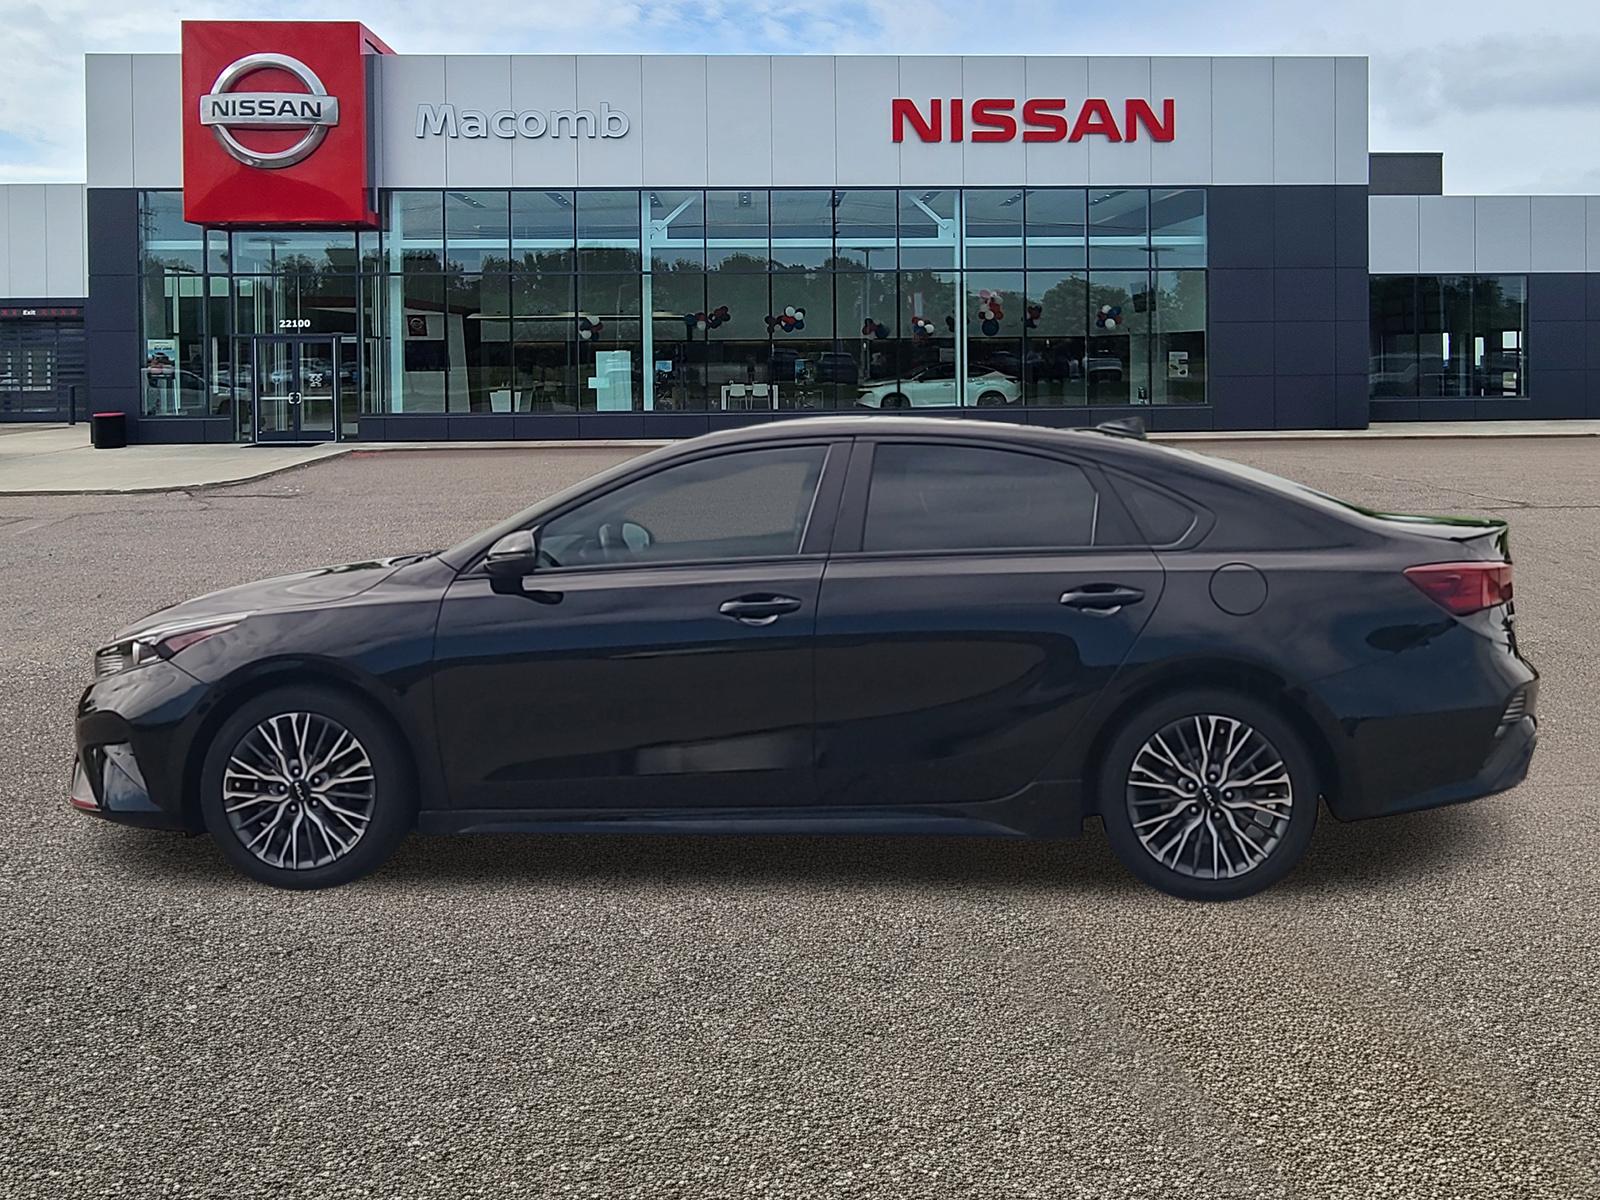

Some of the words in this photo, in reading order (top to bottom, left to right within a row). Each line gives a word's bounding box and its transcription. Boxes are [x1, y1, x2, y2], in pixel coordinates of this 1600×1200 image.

[211, 99, 323, 119] NISSAN
[415, 101, 630, 139] Macomb
[892, 98, 1175, 142] NISSAN
[279, 319, 311, 328] 22100
